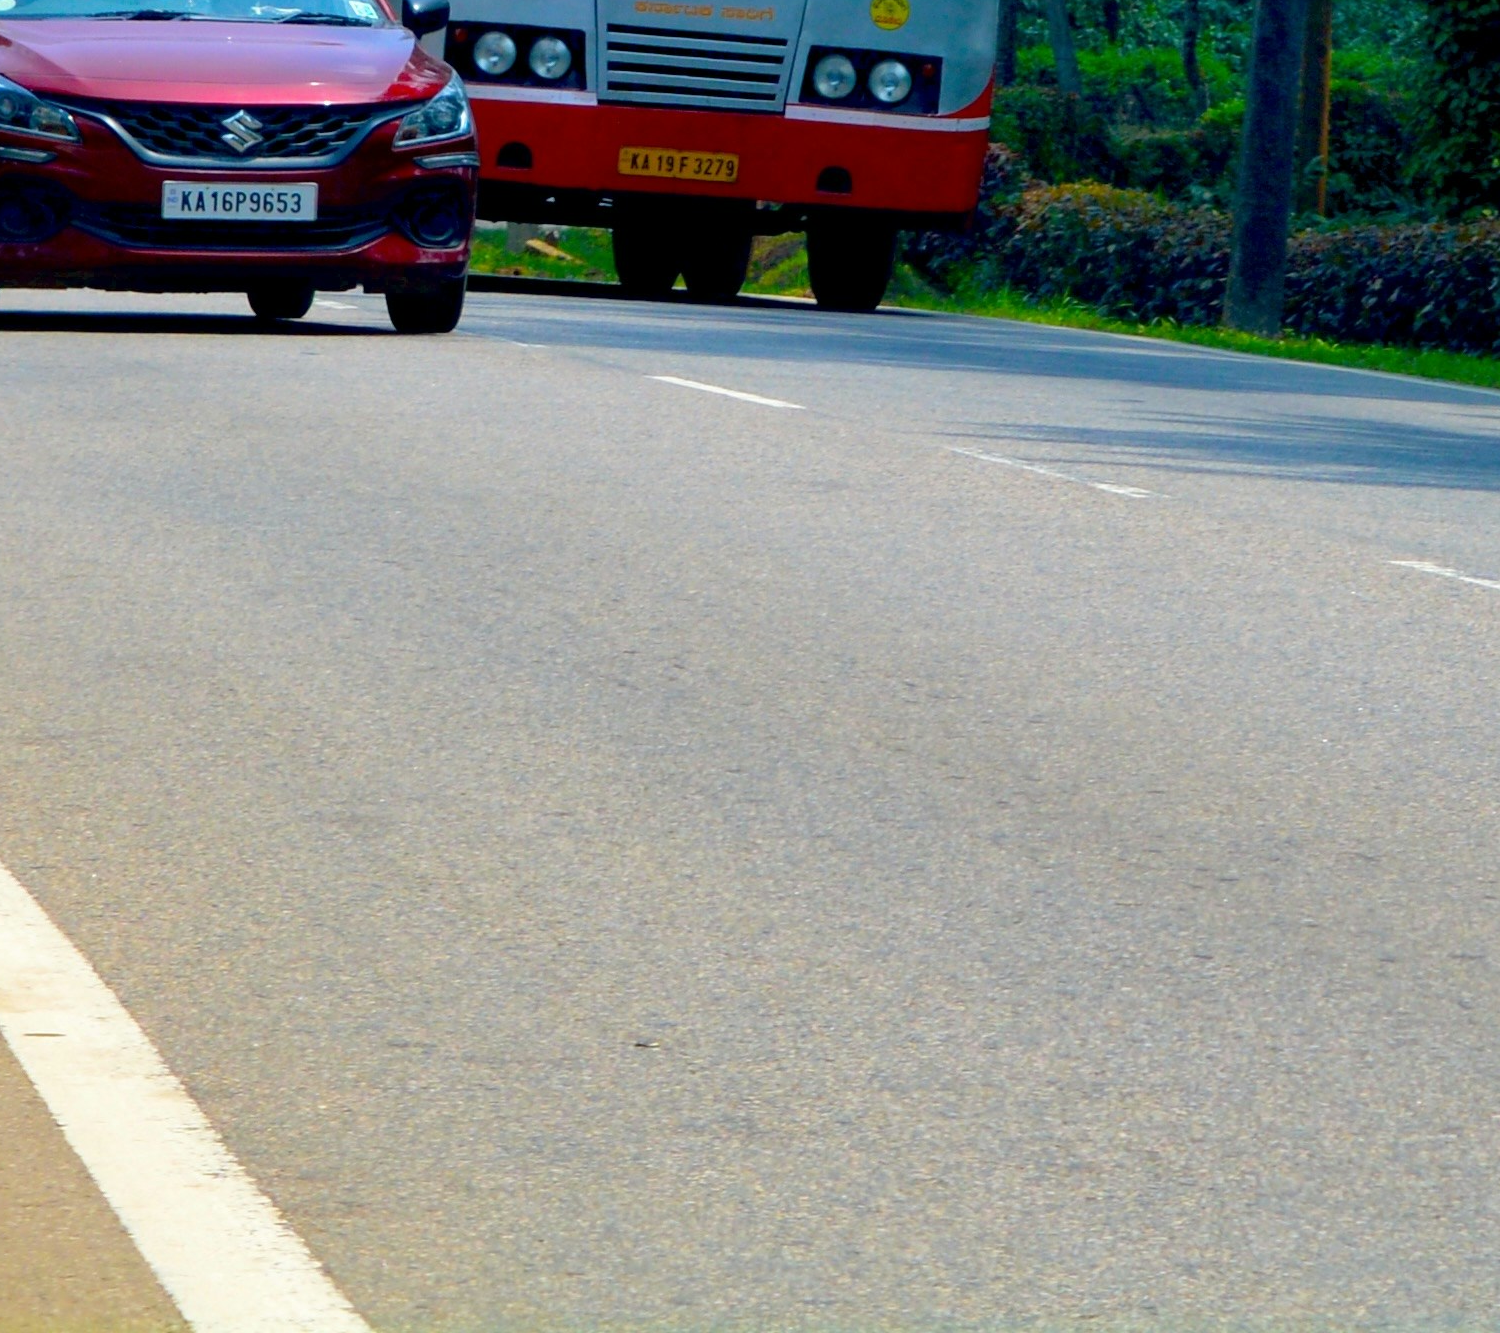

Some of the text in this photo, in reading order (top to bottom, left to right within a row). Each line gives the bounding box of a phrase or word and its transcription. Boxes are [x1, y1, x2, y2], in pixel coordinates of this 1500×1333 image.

[630, 153, 735, 177] KA 19 F 3279
[181, 190, 302, 214] KA16P9653
